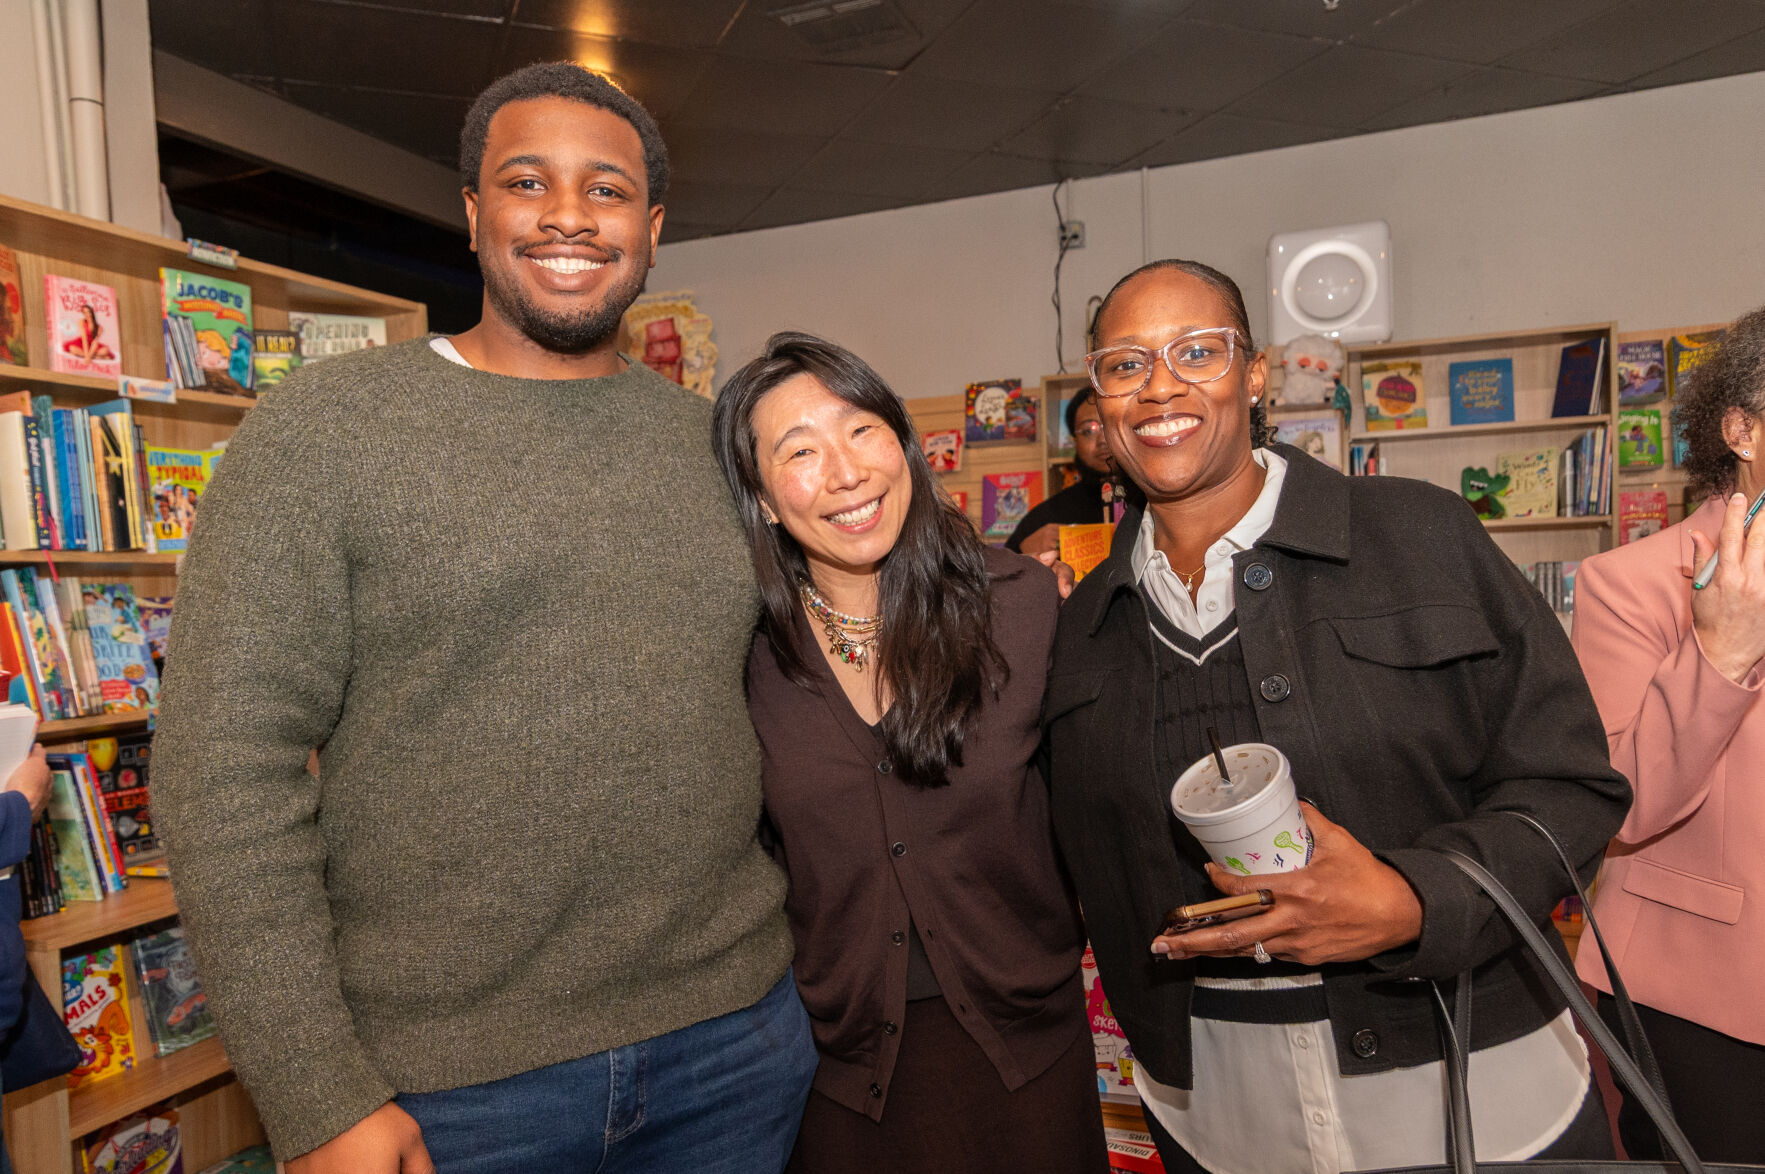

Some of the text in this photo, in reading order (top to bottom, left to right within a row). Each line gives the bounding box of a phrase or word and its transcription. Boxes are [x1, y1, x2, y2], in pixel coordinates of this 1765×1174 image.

[1064, 529, 1104, 549] ADVENTURE
[1064, 542, 1105, 563] CLASSICS
[1129, 1132, 1153, 1144] URS
